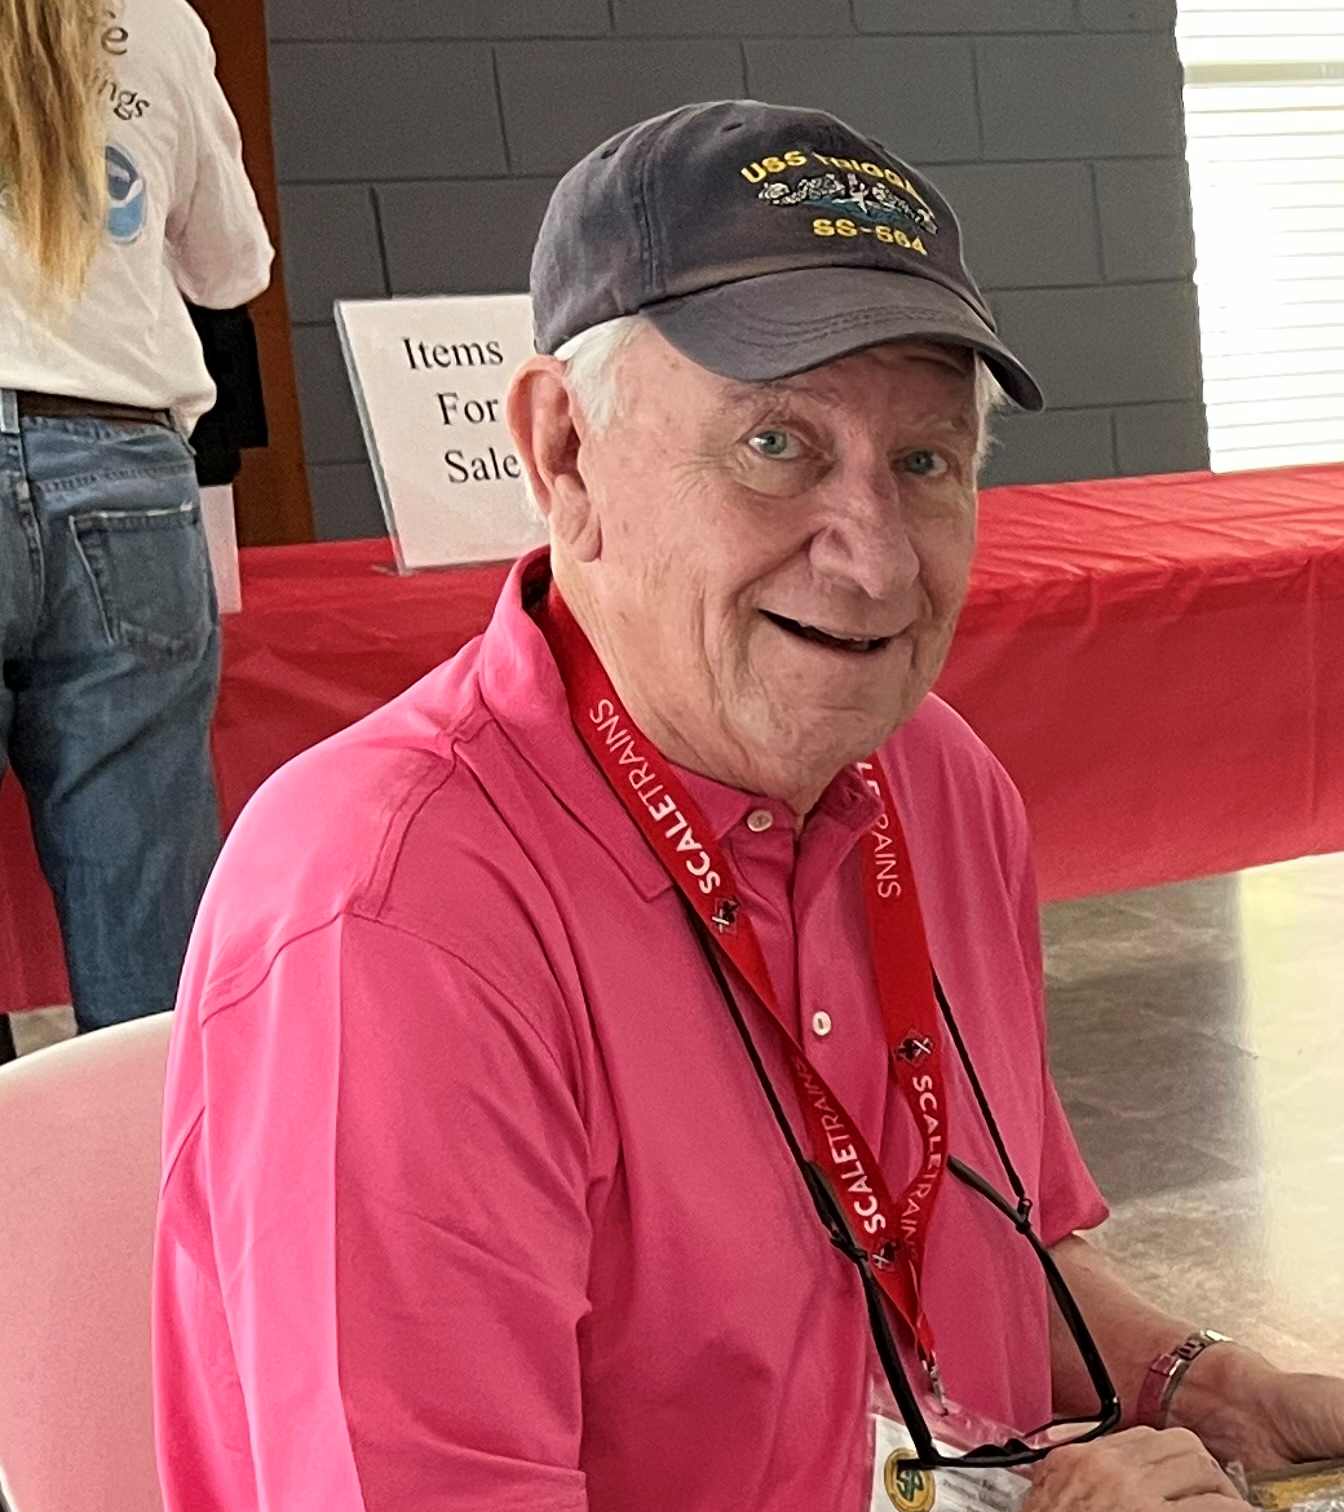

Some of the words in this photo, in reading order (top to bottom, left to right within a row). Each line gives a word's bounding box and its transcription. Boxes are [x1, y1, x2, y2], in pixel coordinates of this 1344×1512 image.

[741, 150, 808, 184] USS
[811, 151, 936, 220] TRIGG
[401, 337, 504, 370] Items
[436, 392, 499, 426] For
[444, 447, 522, 484] Sale
[590, 699, 721, 894] SCALETRAINS
